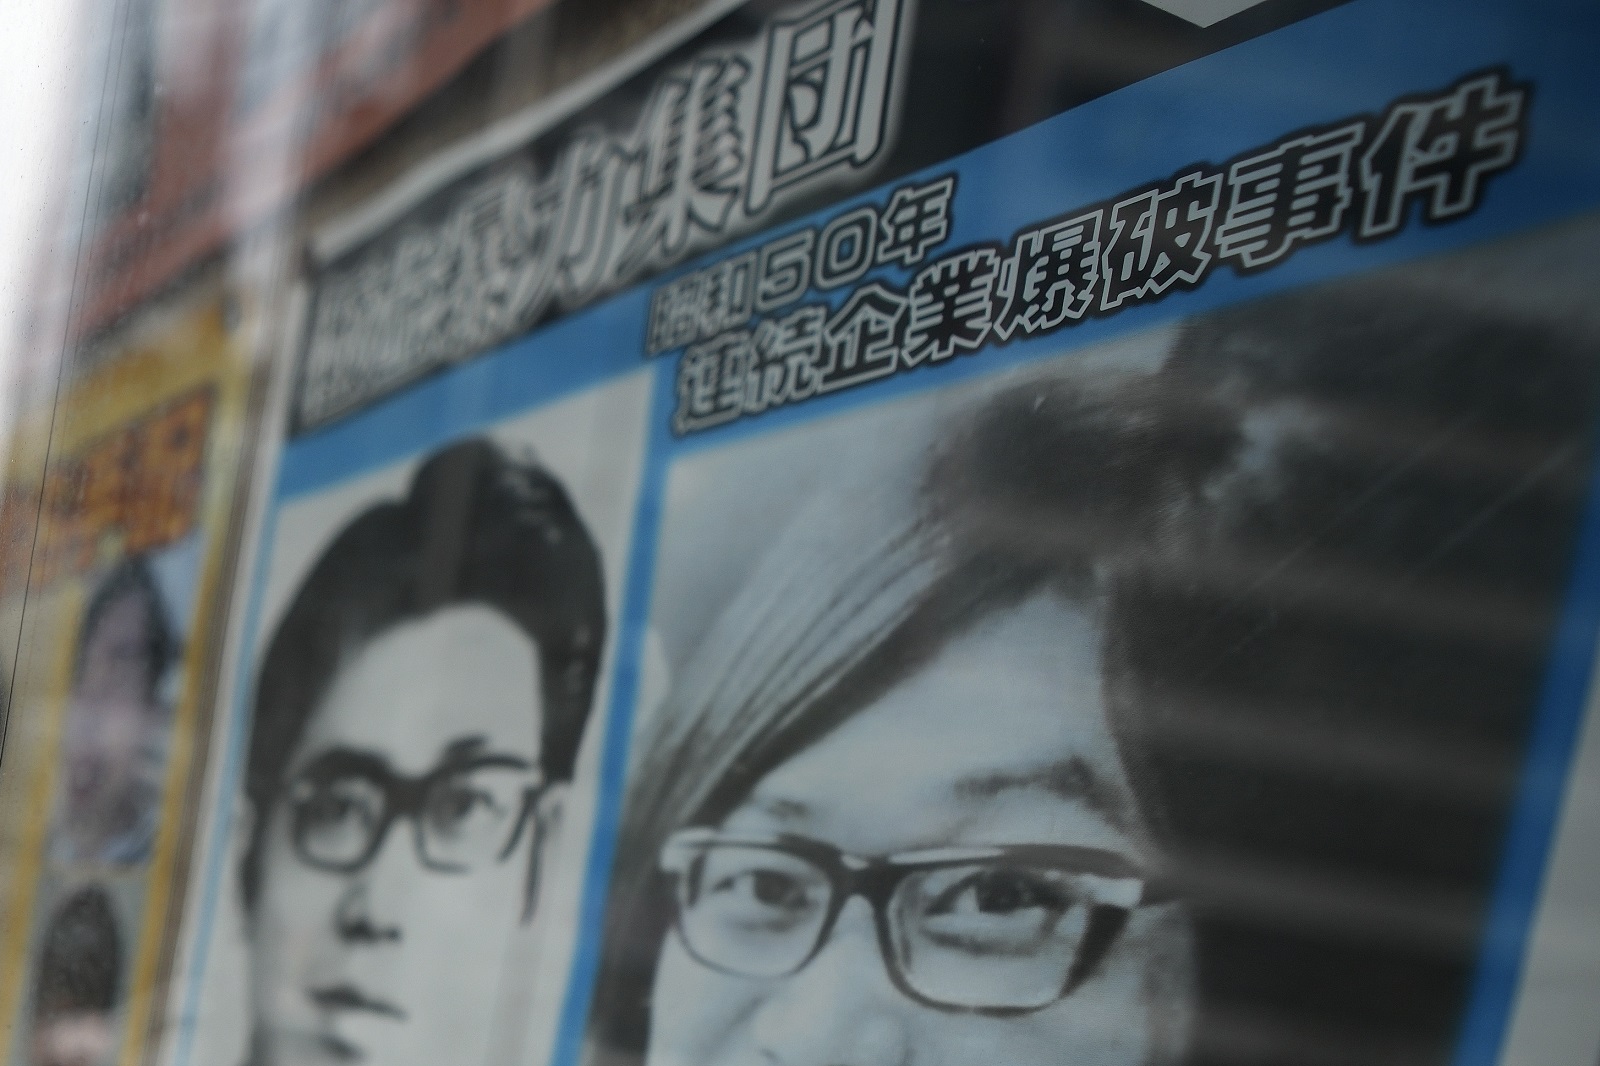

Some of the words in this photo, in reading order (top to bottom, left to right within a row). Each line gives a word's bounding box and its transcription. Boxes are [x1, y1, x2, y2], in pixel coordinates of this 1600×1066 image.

[672, 74, 1524, 434] 連続企業爆破事件
